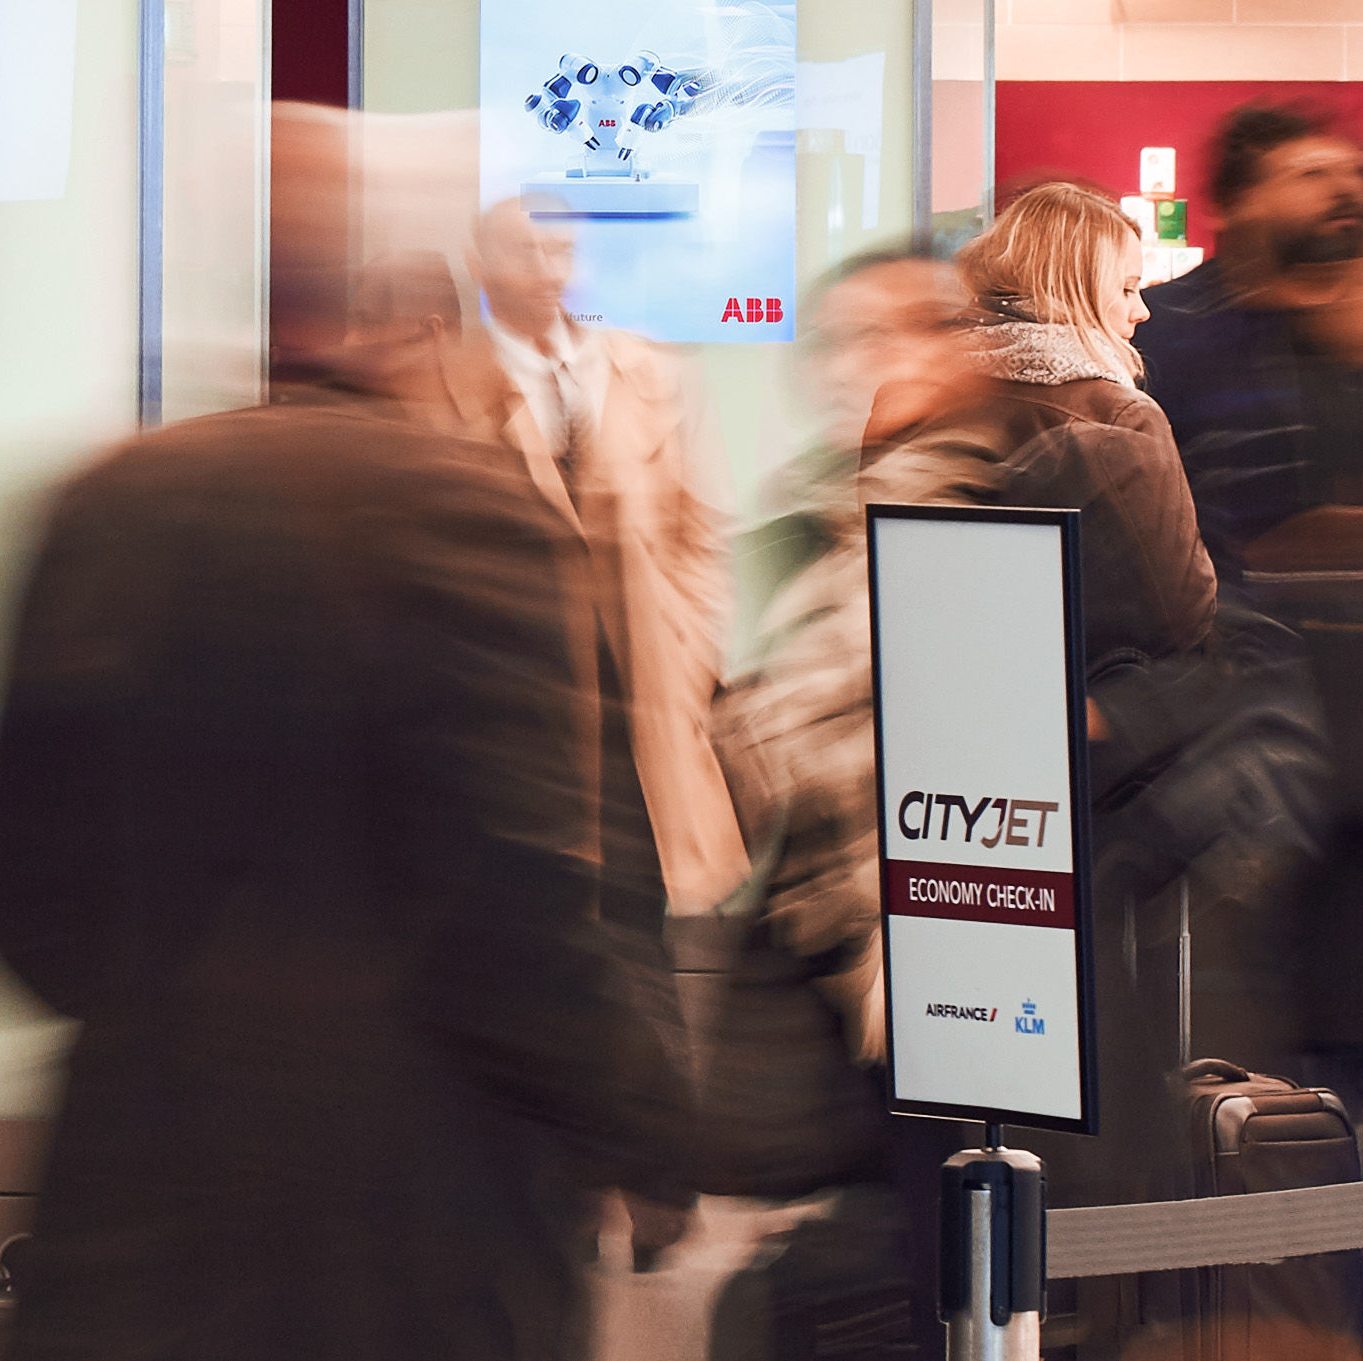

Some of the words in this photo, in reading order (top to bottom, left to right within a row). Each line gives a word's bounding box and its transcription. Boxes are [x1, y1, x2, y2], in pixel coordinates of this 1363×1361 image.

[721, 297, 784, 323] ABB
[898, 790, 1059, 849] CITYJET
[909, 877, 983, 906] ECONOMY
[986, 884, 1055, 912] CHECK-IN
[926, 1002, 988, 1022] AIRFRANCE
[1015, 1017, 1045, 1035] KLM
